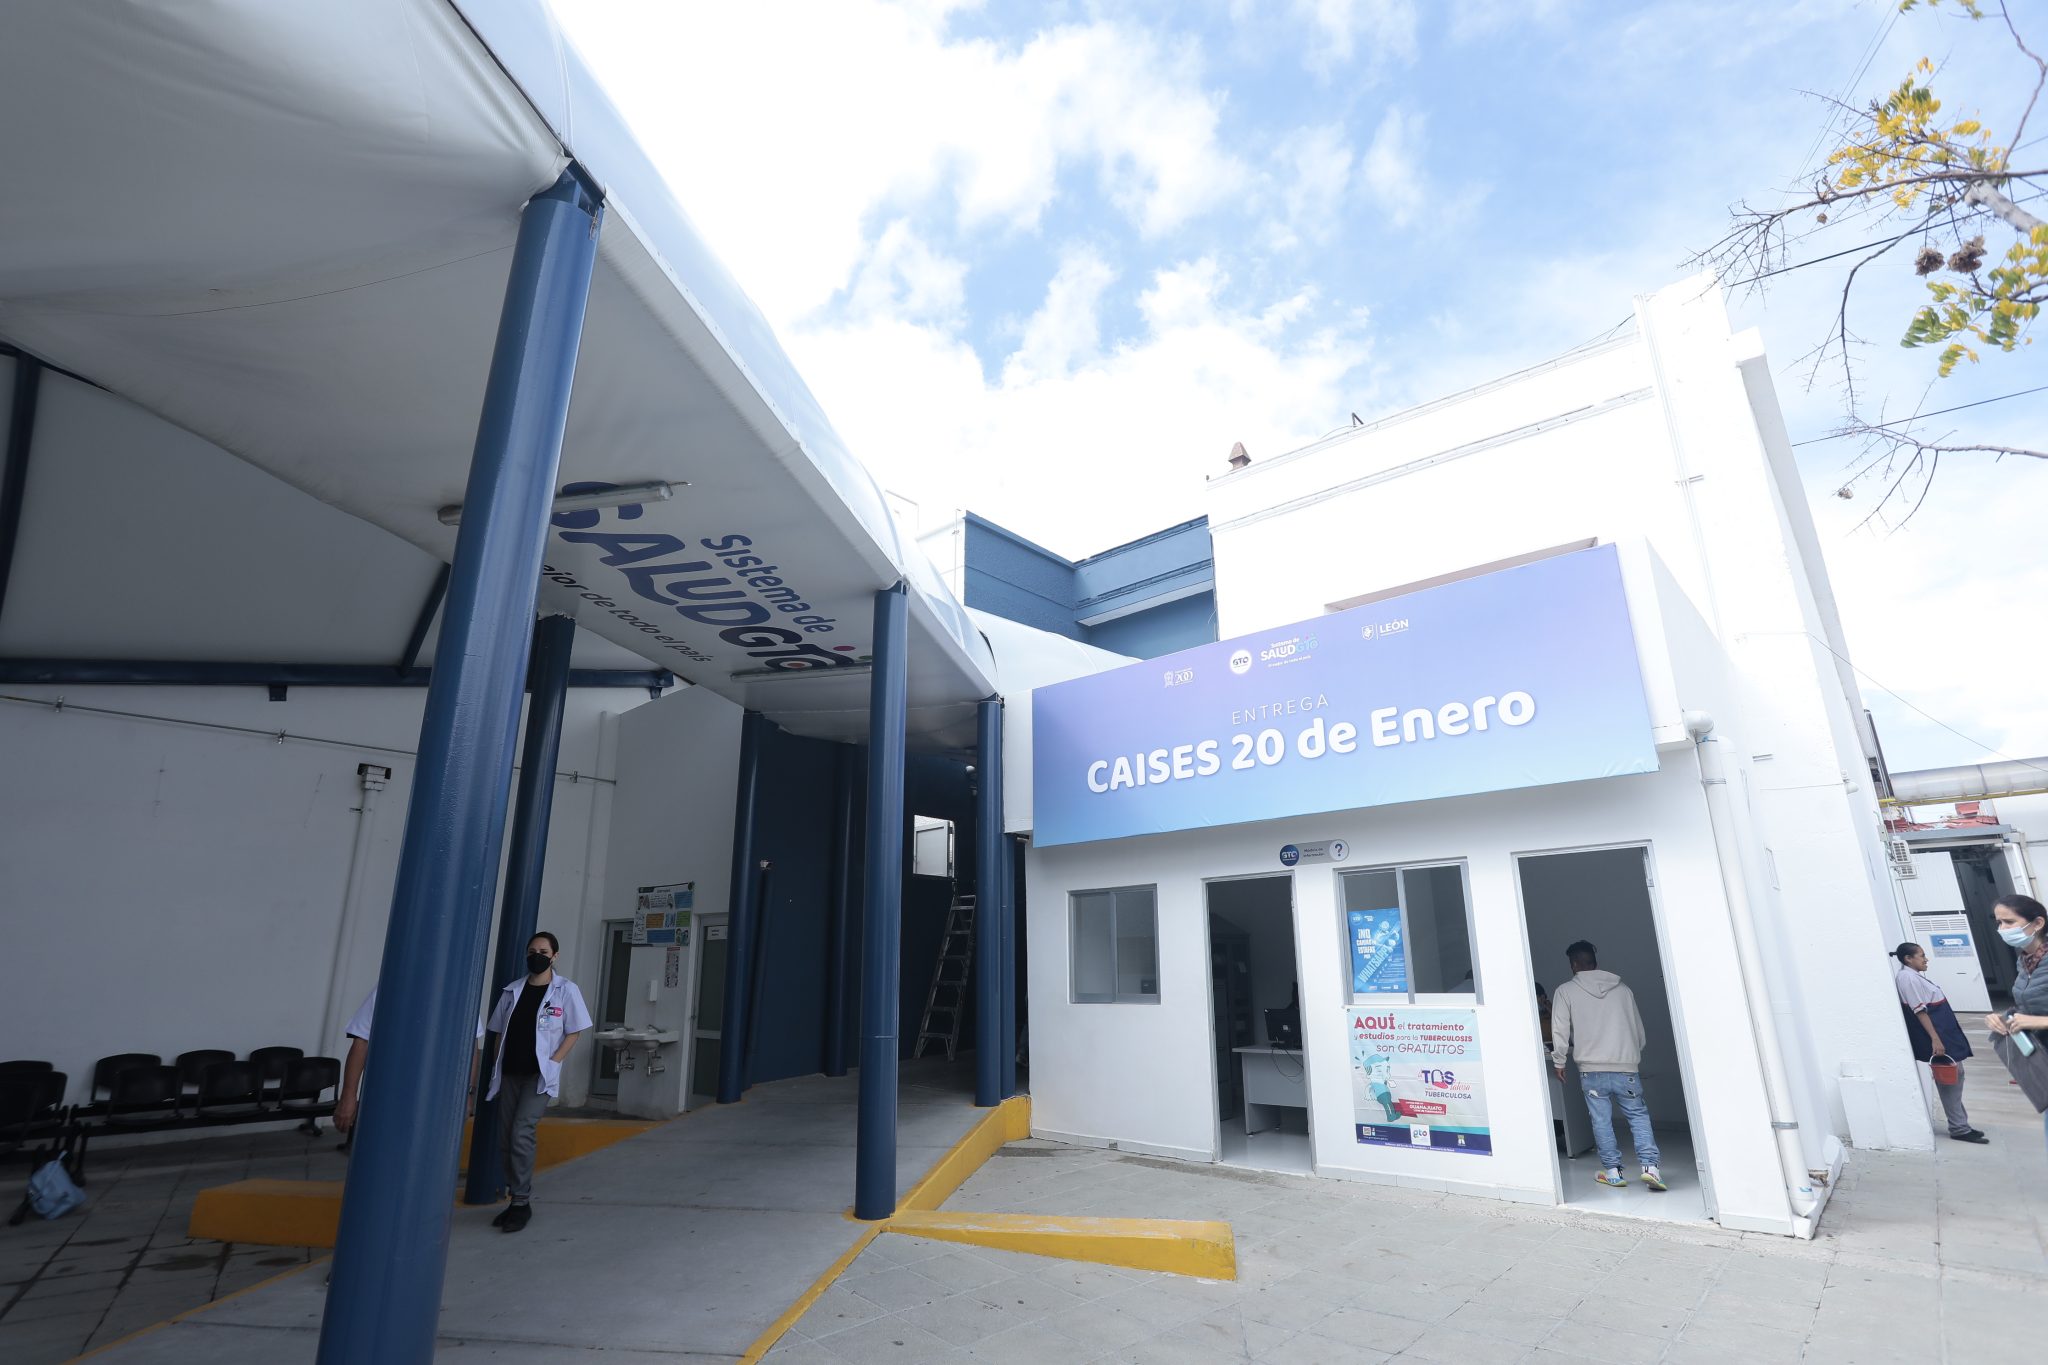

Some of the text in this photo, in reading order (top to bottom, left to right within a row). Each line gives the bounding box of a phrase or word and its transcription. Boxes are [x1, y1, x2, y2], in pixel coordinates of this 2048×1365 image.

[701, 534, 836, 633] Sistema de
[580, 592, 616, 608] de
[608, 609, 661, 634] todo
[654, 635, 685, 644] el
[1380, 618, 1409, 634] LEÓN
[1232, 656, 1249, 666] GTO
[1232, 694, 1329, 725] ENTREGA
[1087, 691, 1536, 793] CAISES 20 de Enero
[1282, 851, 1298, 859] GTO
[1354, 1013, 1465, 1031] AQUÍ el tratamiento
[1359, 1032, 1395, 1040] estudios
[1376, 1043, 1465, 1055] son GRATUITOS
[1425, 1090, 1472, 1100] TUBERCULOSA
[1413, 1128, 1428, 1138] gto
